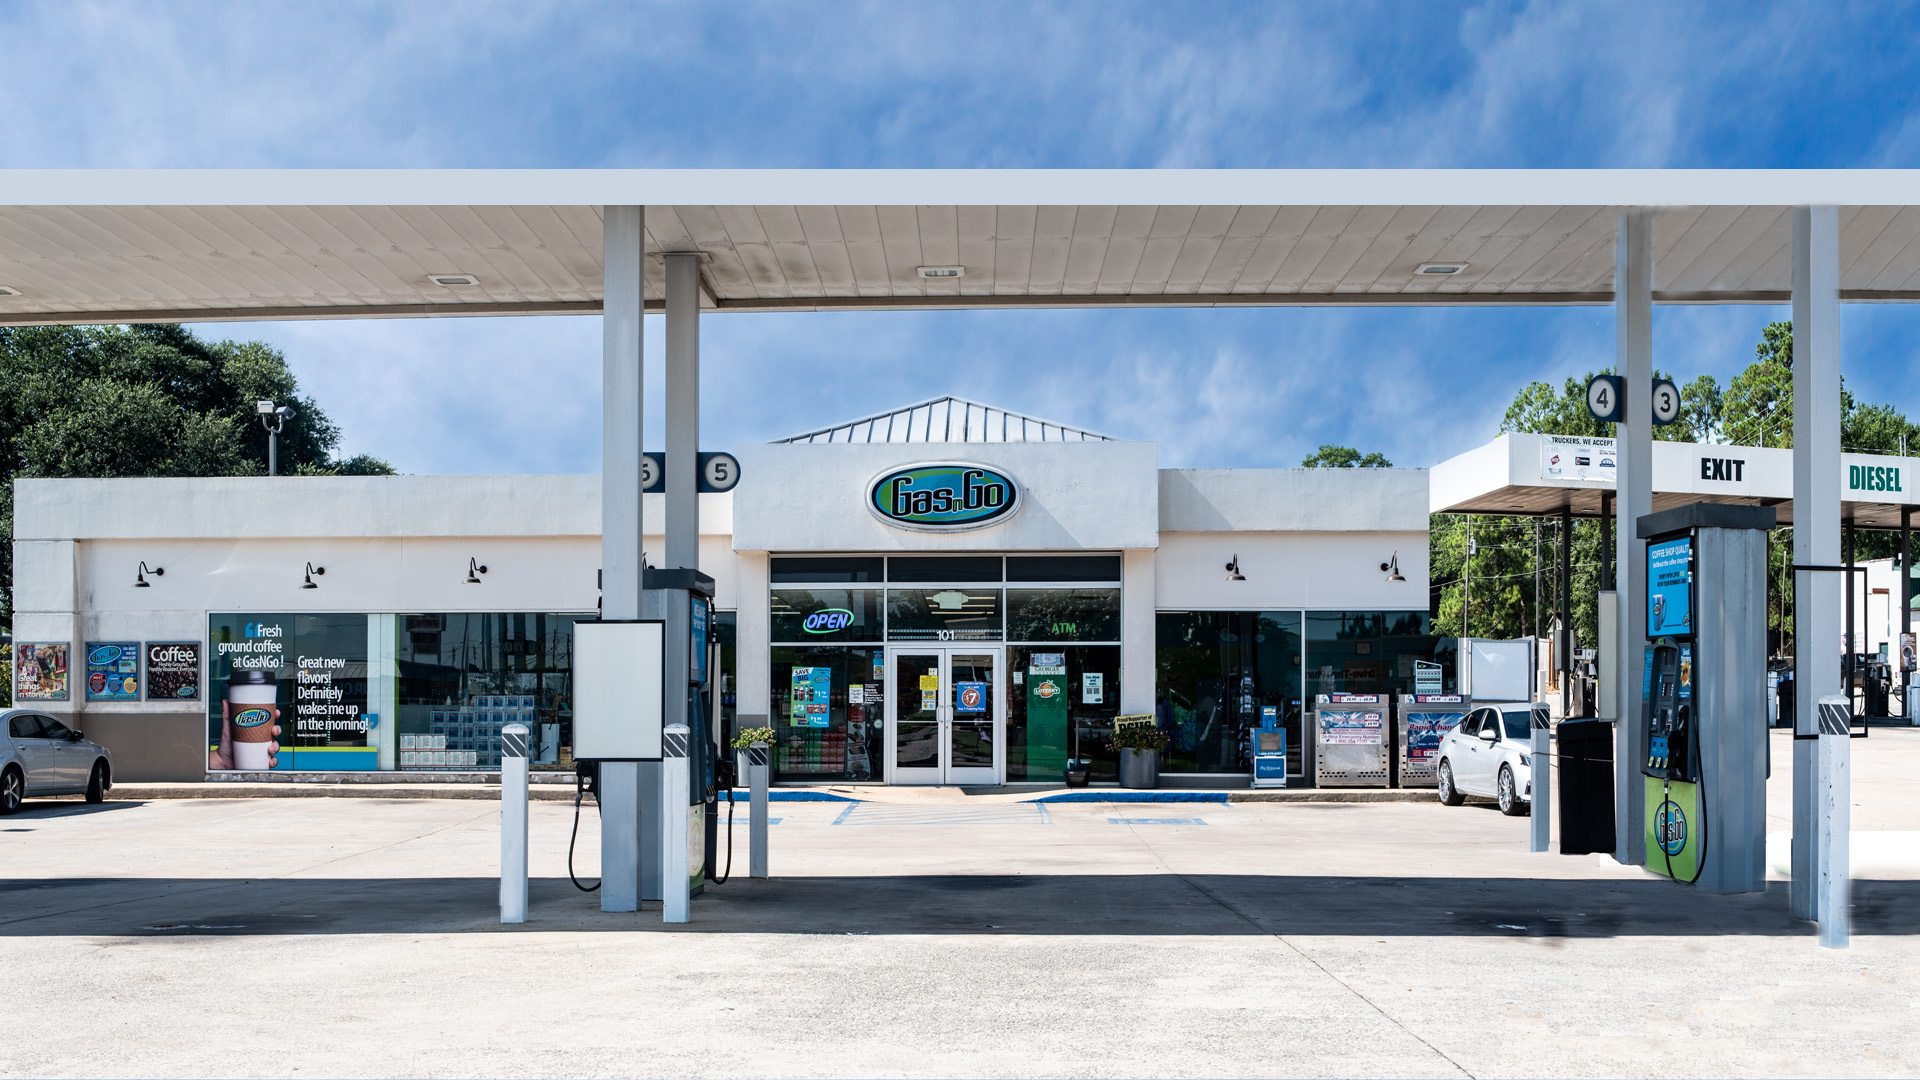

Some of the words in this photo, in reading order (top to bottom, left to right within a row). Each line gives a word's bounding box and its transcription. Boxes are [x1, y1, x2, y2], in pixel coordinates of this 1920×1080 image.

[1596, 388, 1609, 408] 4
[1660, 392, 1671, 413] 3
[1552, 436, 1581, 445] TRUCKERS,
[1592, 439, 1613, 447] ACCEPT
[714, 463, 728, 481] 5
[1701, 457, 1745, 482] EXIT
[1849, 465, 1902, 492] DIESEL
[1652, 548, 1666, 559] COFFEE
[1665, 546, 1675, 556] SHOP
[806, 613, 849, 629] OPEN
[1051, 622, 1076, 633] ATM
[257, 624, 282, 637] Fresh
[936, 630, 956, 641] 101
[151, 646, 197, 662] Coffee.
[218, 640, 252, 655] ground
[253, 640, 282, 652] coffee
[233, 656, 242, 668] at
[243, 655, 279, 668] GasNGo
[297, 655, 323, 669] Great
[324, 658, 346, 669] new
[18, 674, 38, 682] Great
[297, 670, 331, 684] flavors!
[18, 682, 40, 692] things
[297, 686, 343, 702] Definitely
[297, 701, 327, 715] wakes
[328, 704, 345, 715] me
[345, 704, 359, 717] up
[297, 717, 306, 730] in
[308, 717, 325, 730] the
[325, 717, 369, 734] morning!
[1409, 724, 1432, 732] Rapid
